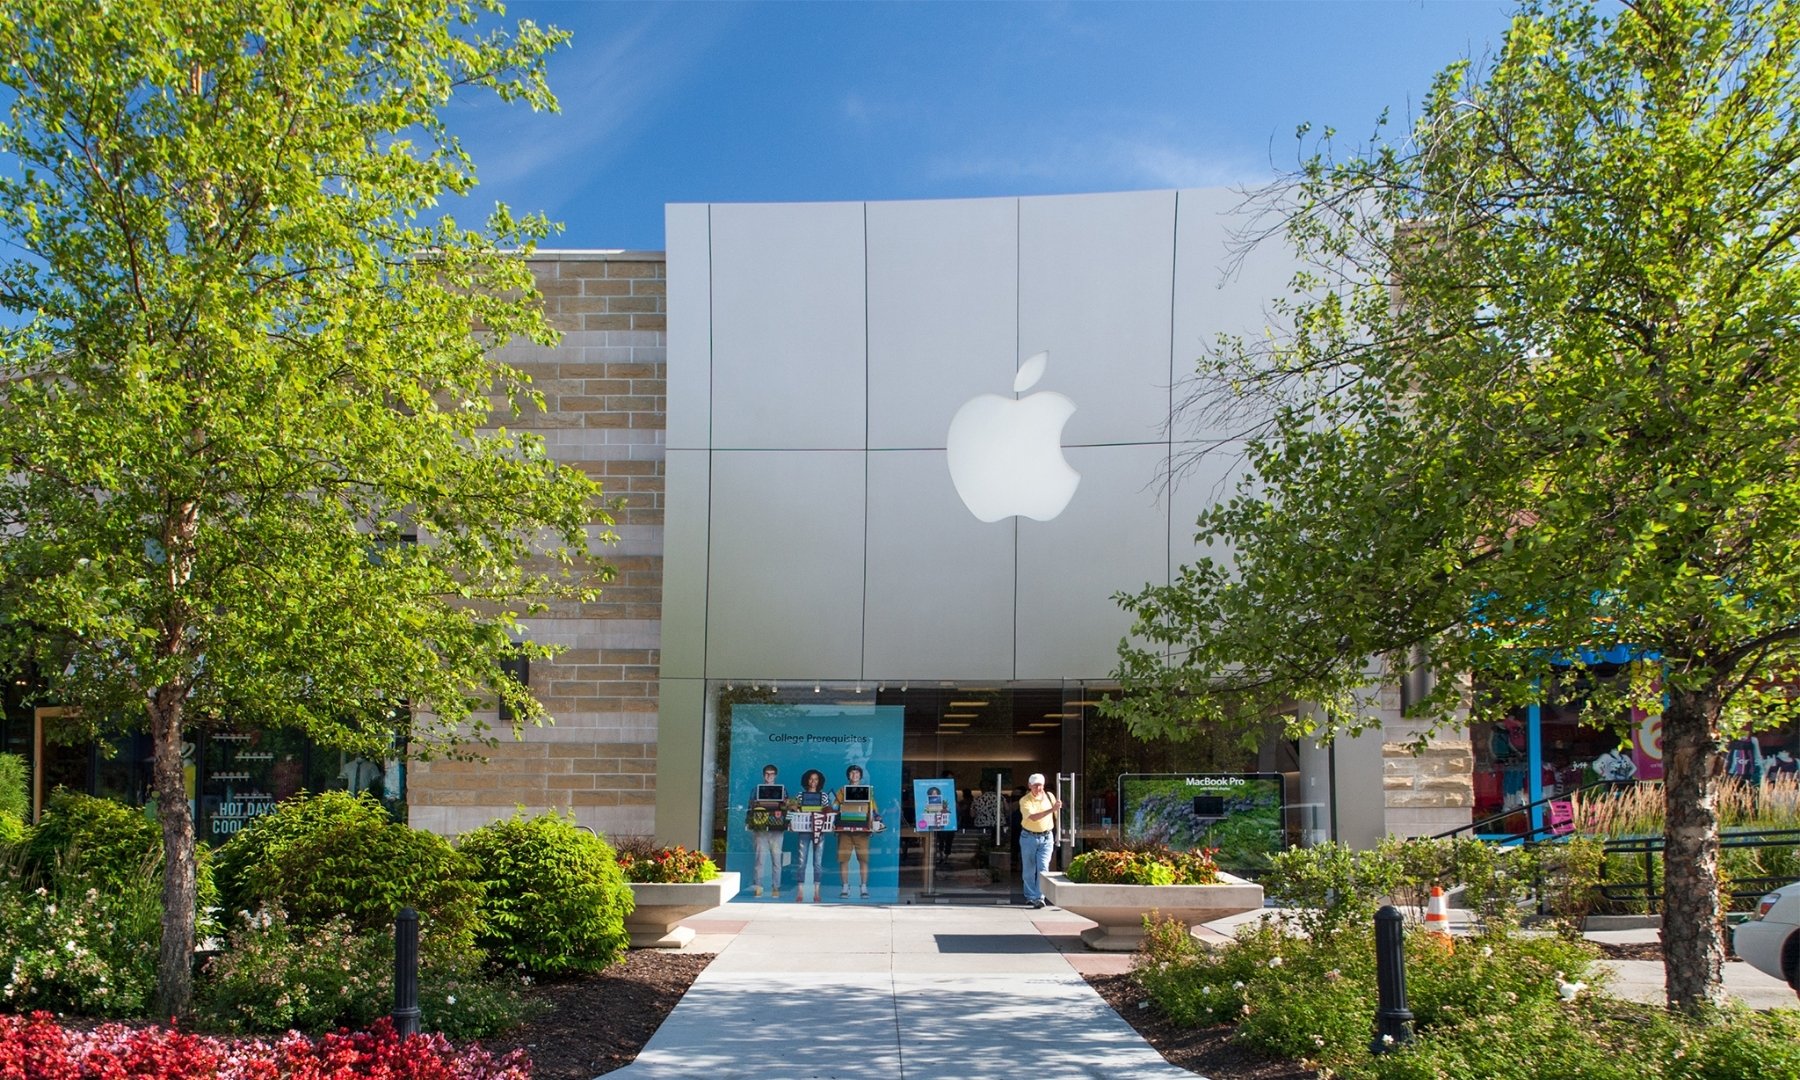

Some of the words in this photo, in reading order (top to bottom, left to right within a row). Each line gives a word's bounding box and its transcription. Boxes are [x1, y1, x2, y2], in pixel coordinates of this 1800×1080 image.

[768, 733, 804, 744] College
[806, 733, 868, 744] Prerequisites
[1186, 777, 1228, 786] MacBook
[1229, 777, 1245, 786] Pro
[219, 802, 244, 816] HOT
[247, 802, 277, 816] DAYS
